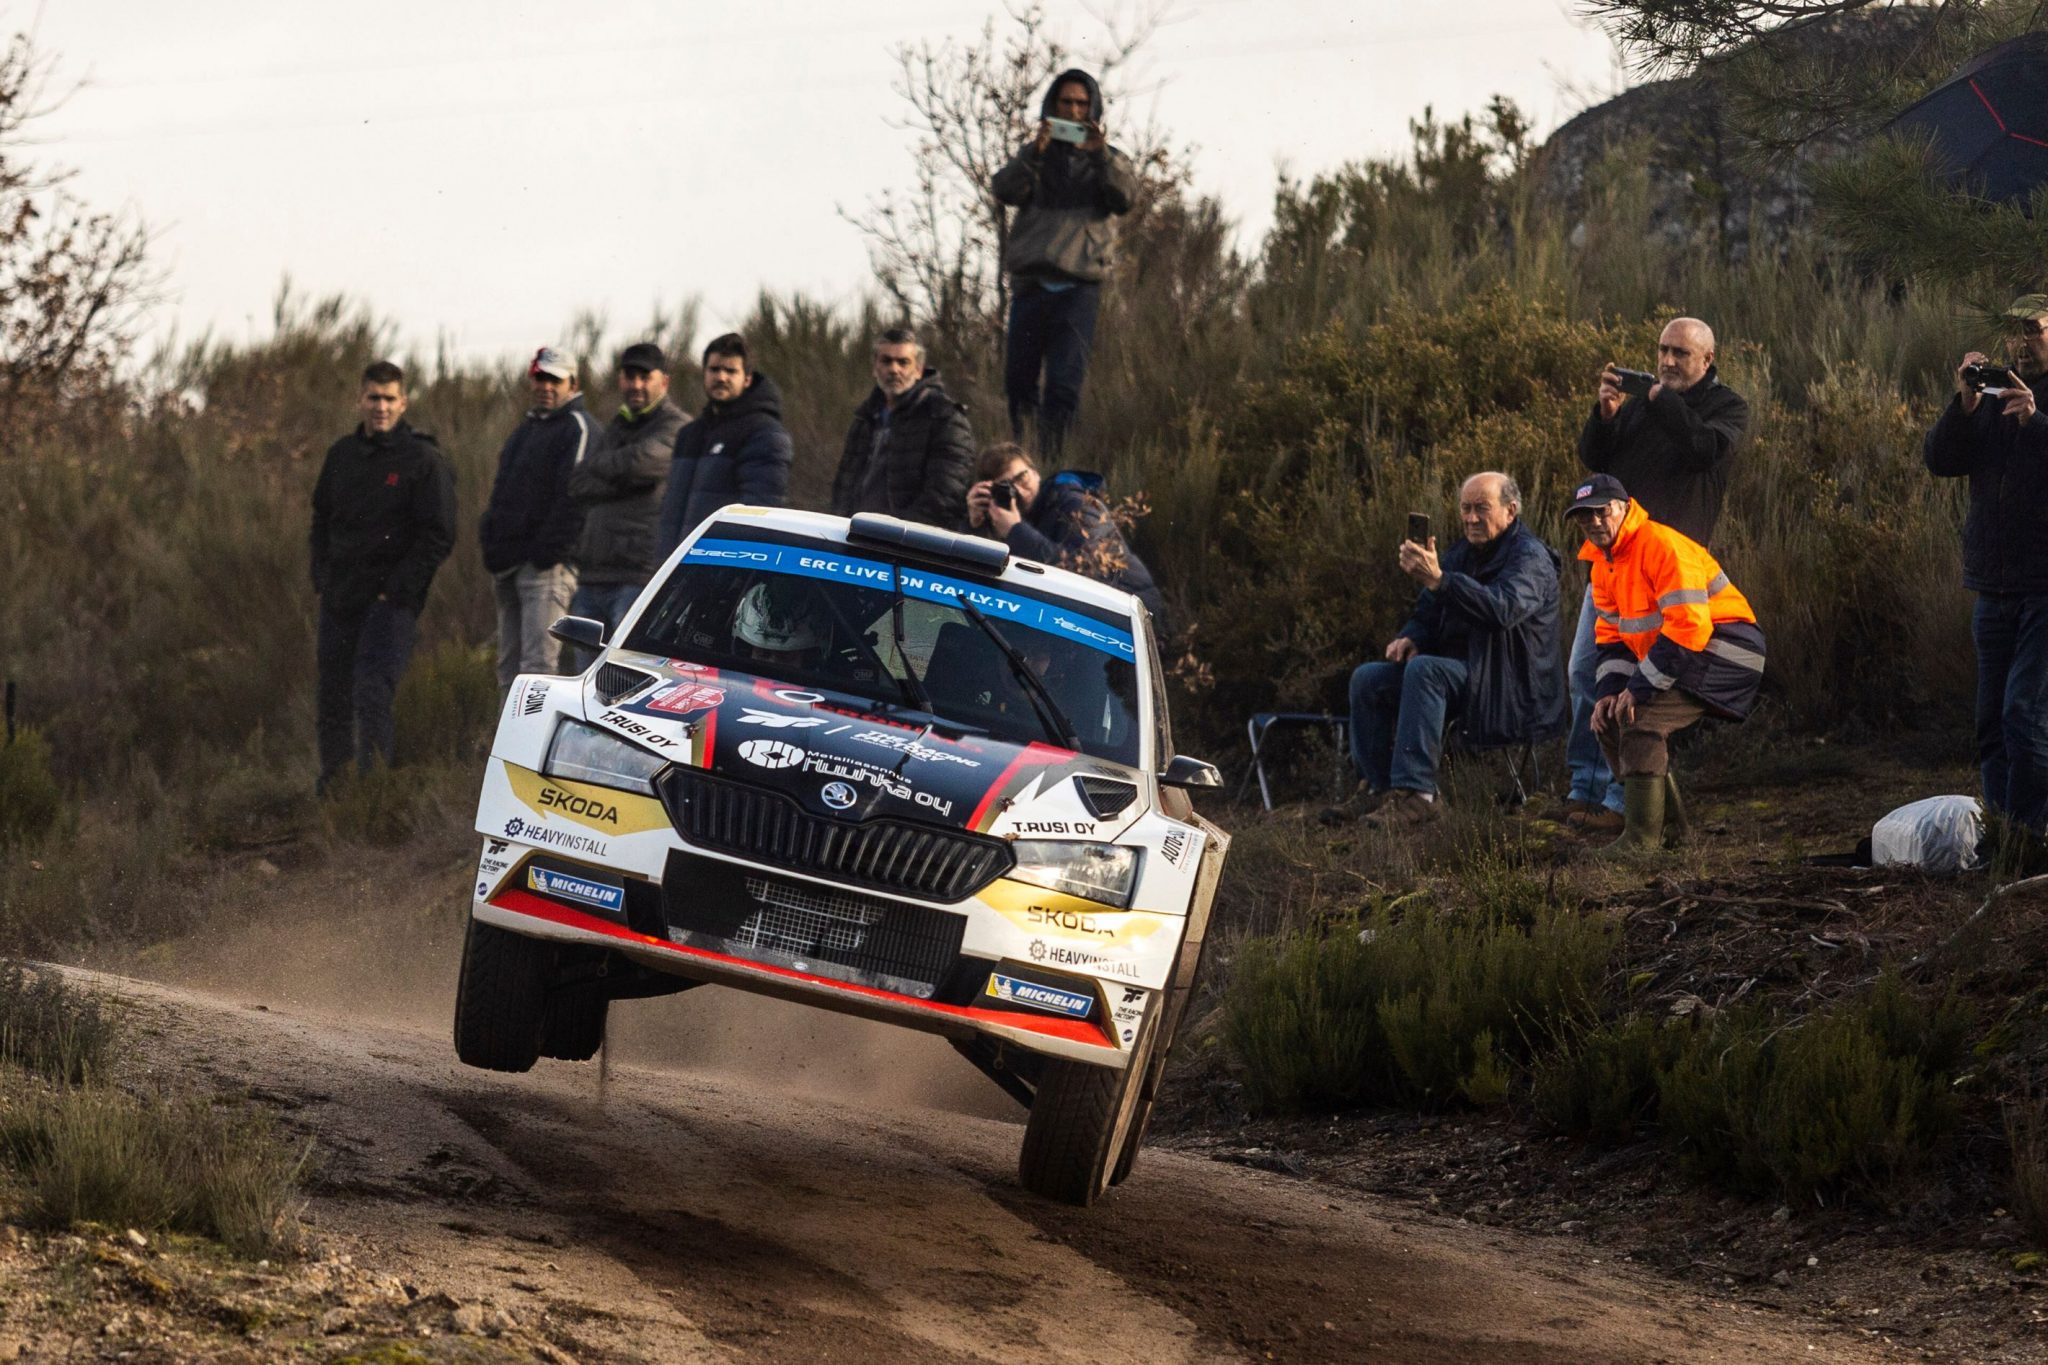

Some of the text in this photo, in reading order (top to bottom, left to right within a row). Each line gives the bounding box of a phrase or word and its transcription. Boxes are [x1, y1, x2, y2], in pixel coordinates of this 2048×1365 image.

[800, 556, 839, 573] ERC
[844, 564, 890, 582] LIVE
[600, 710, 679, 748] T.RUSI OY
[523, 824, 608, 857] HEAVYINSTALL
[1011, 821, 1096, 836] T.RUSI OY
[551, 876, 617, 903] MICHELIN
[1015, 986, 1087, 1012] MICHELIN
